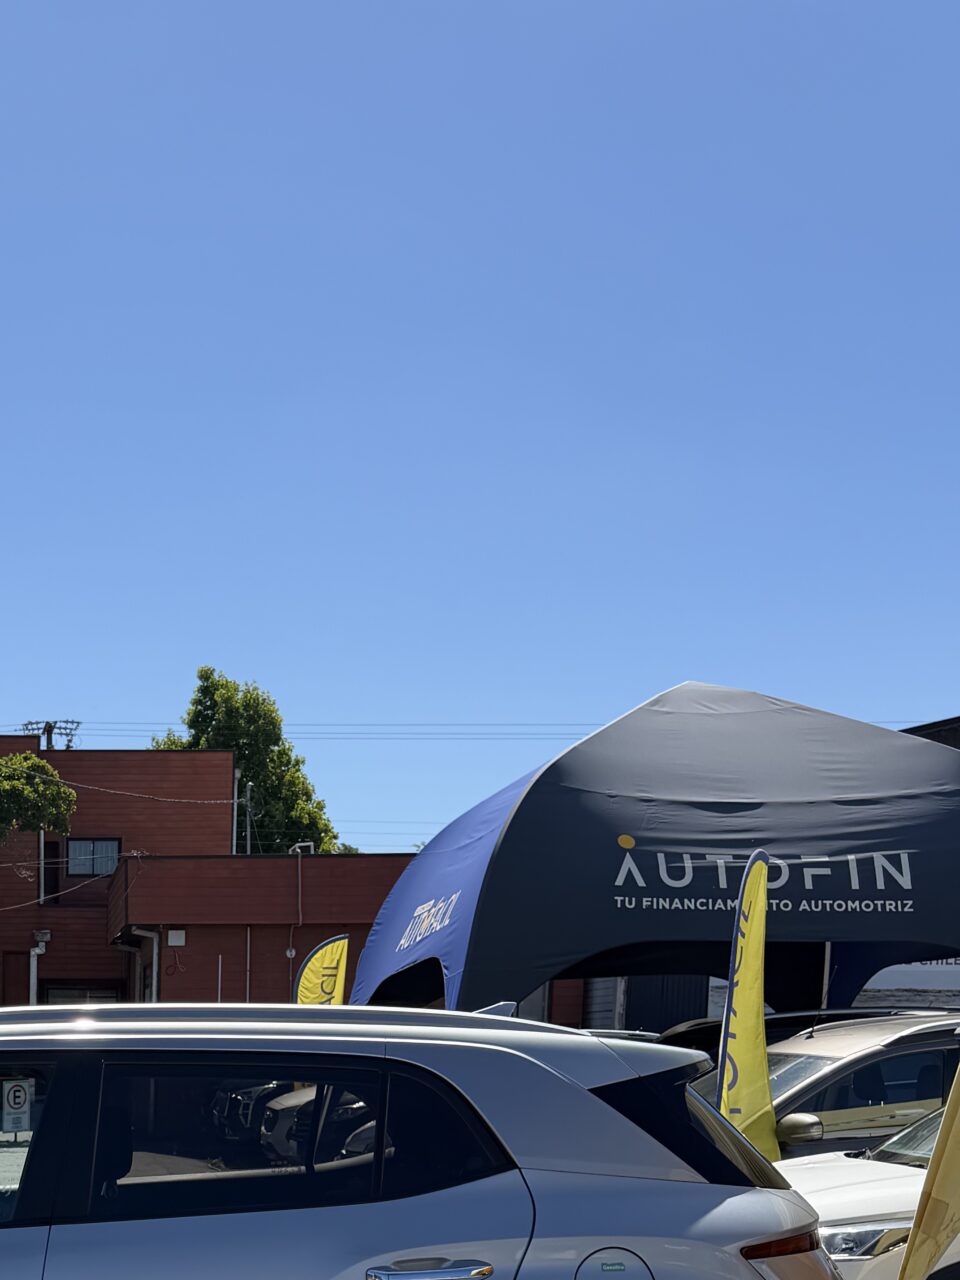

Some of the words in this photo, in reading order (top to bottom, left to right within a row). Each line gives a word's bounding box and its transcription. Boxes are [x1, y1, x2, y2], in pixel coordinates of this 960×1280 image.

[614, 848, 913, 890] AUTOFIN
[614, 896, 636, 909] TU
[642, 896, 792, 912] FINANCIAMTO
[799, 899, 914, 913] AUTOMOTRIZ
[13, 1089, 22, 1106] E
